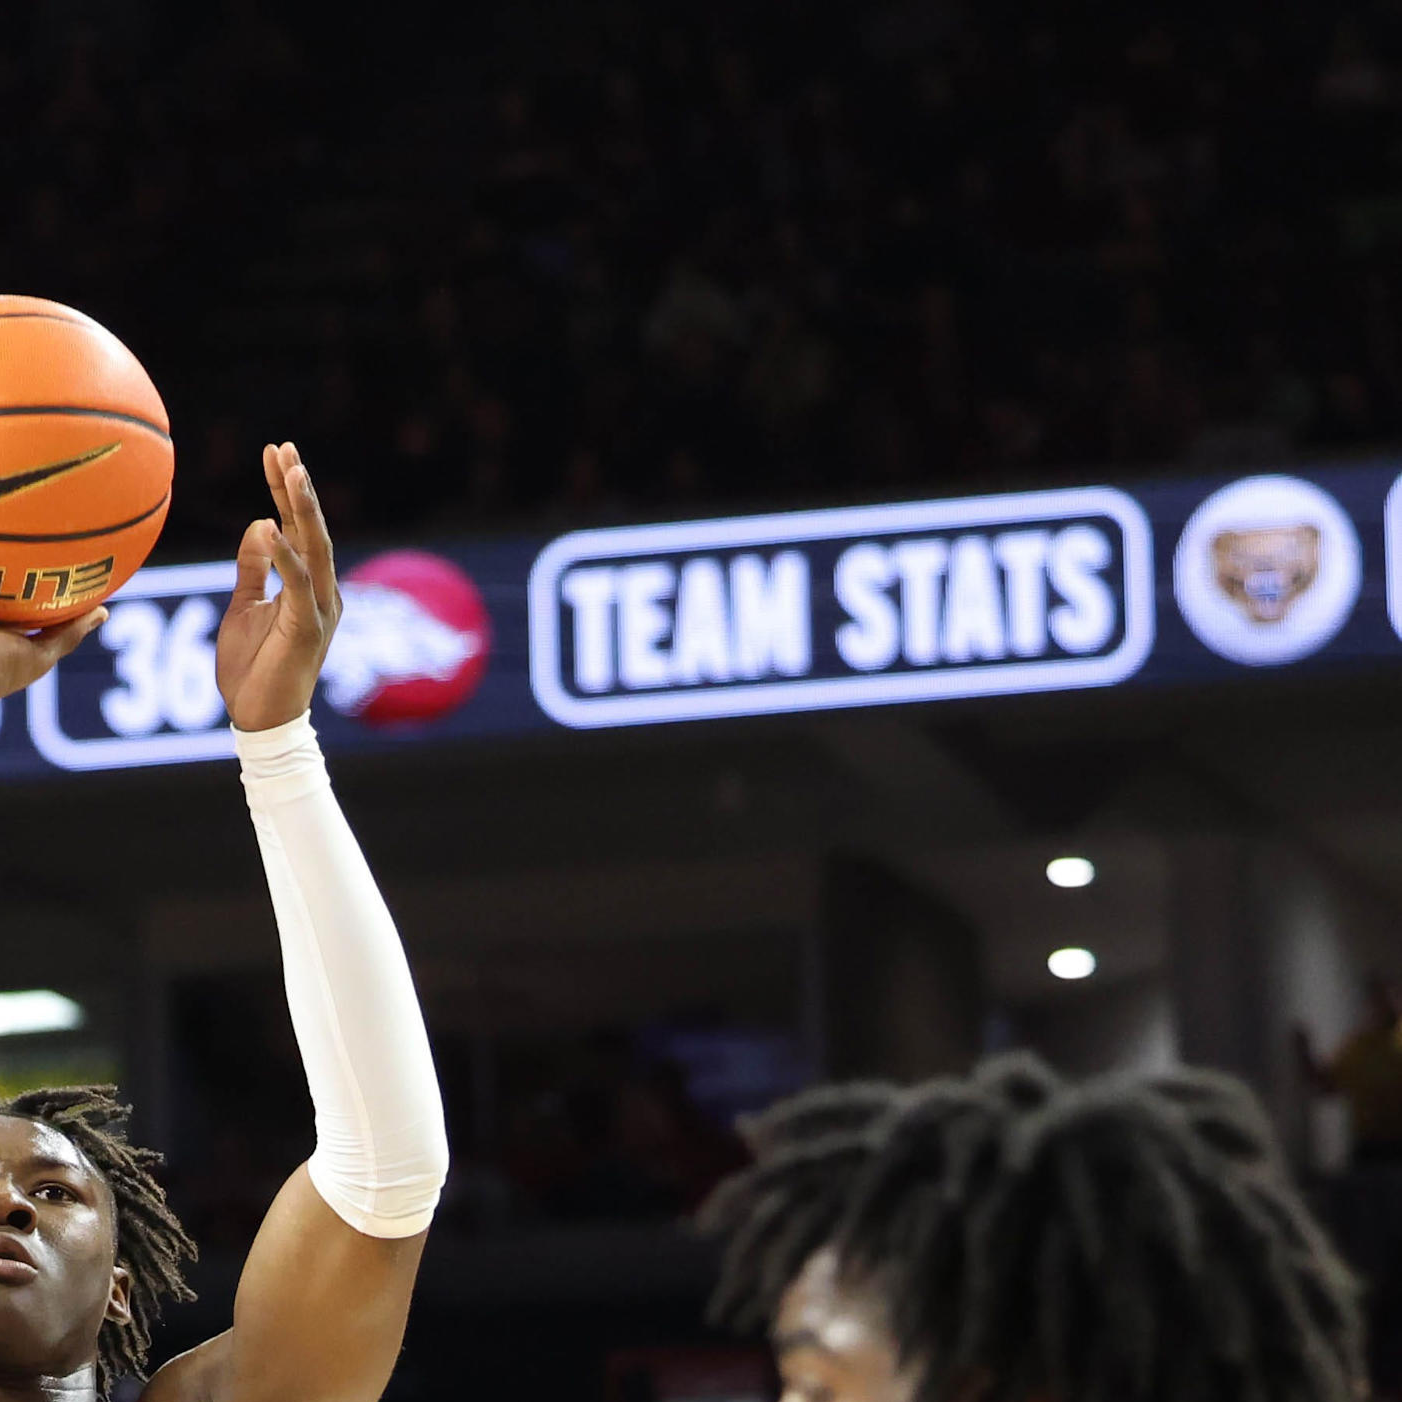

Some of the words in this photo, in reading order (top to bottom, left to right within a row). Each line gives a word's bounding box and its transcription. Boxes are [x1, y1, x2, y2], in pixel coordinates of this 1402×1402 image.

[99, 596, 226, 738] 36
[562, 550, 811, 694] TEAM
[834, 524, 1114, 671] STATS
